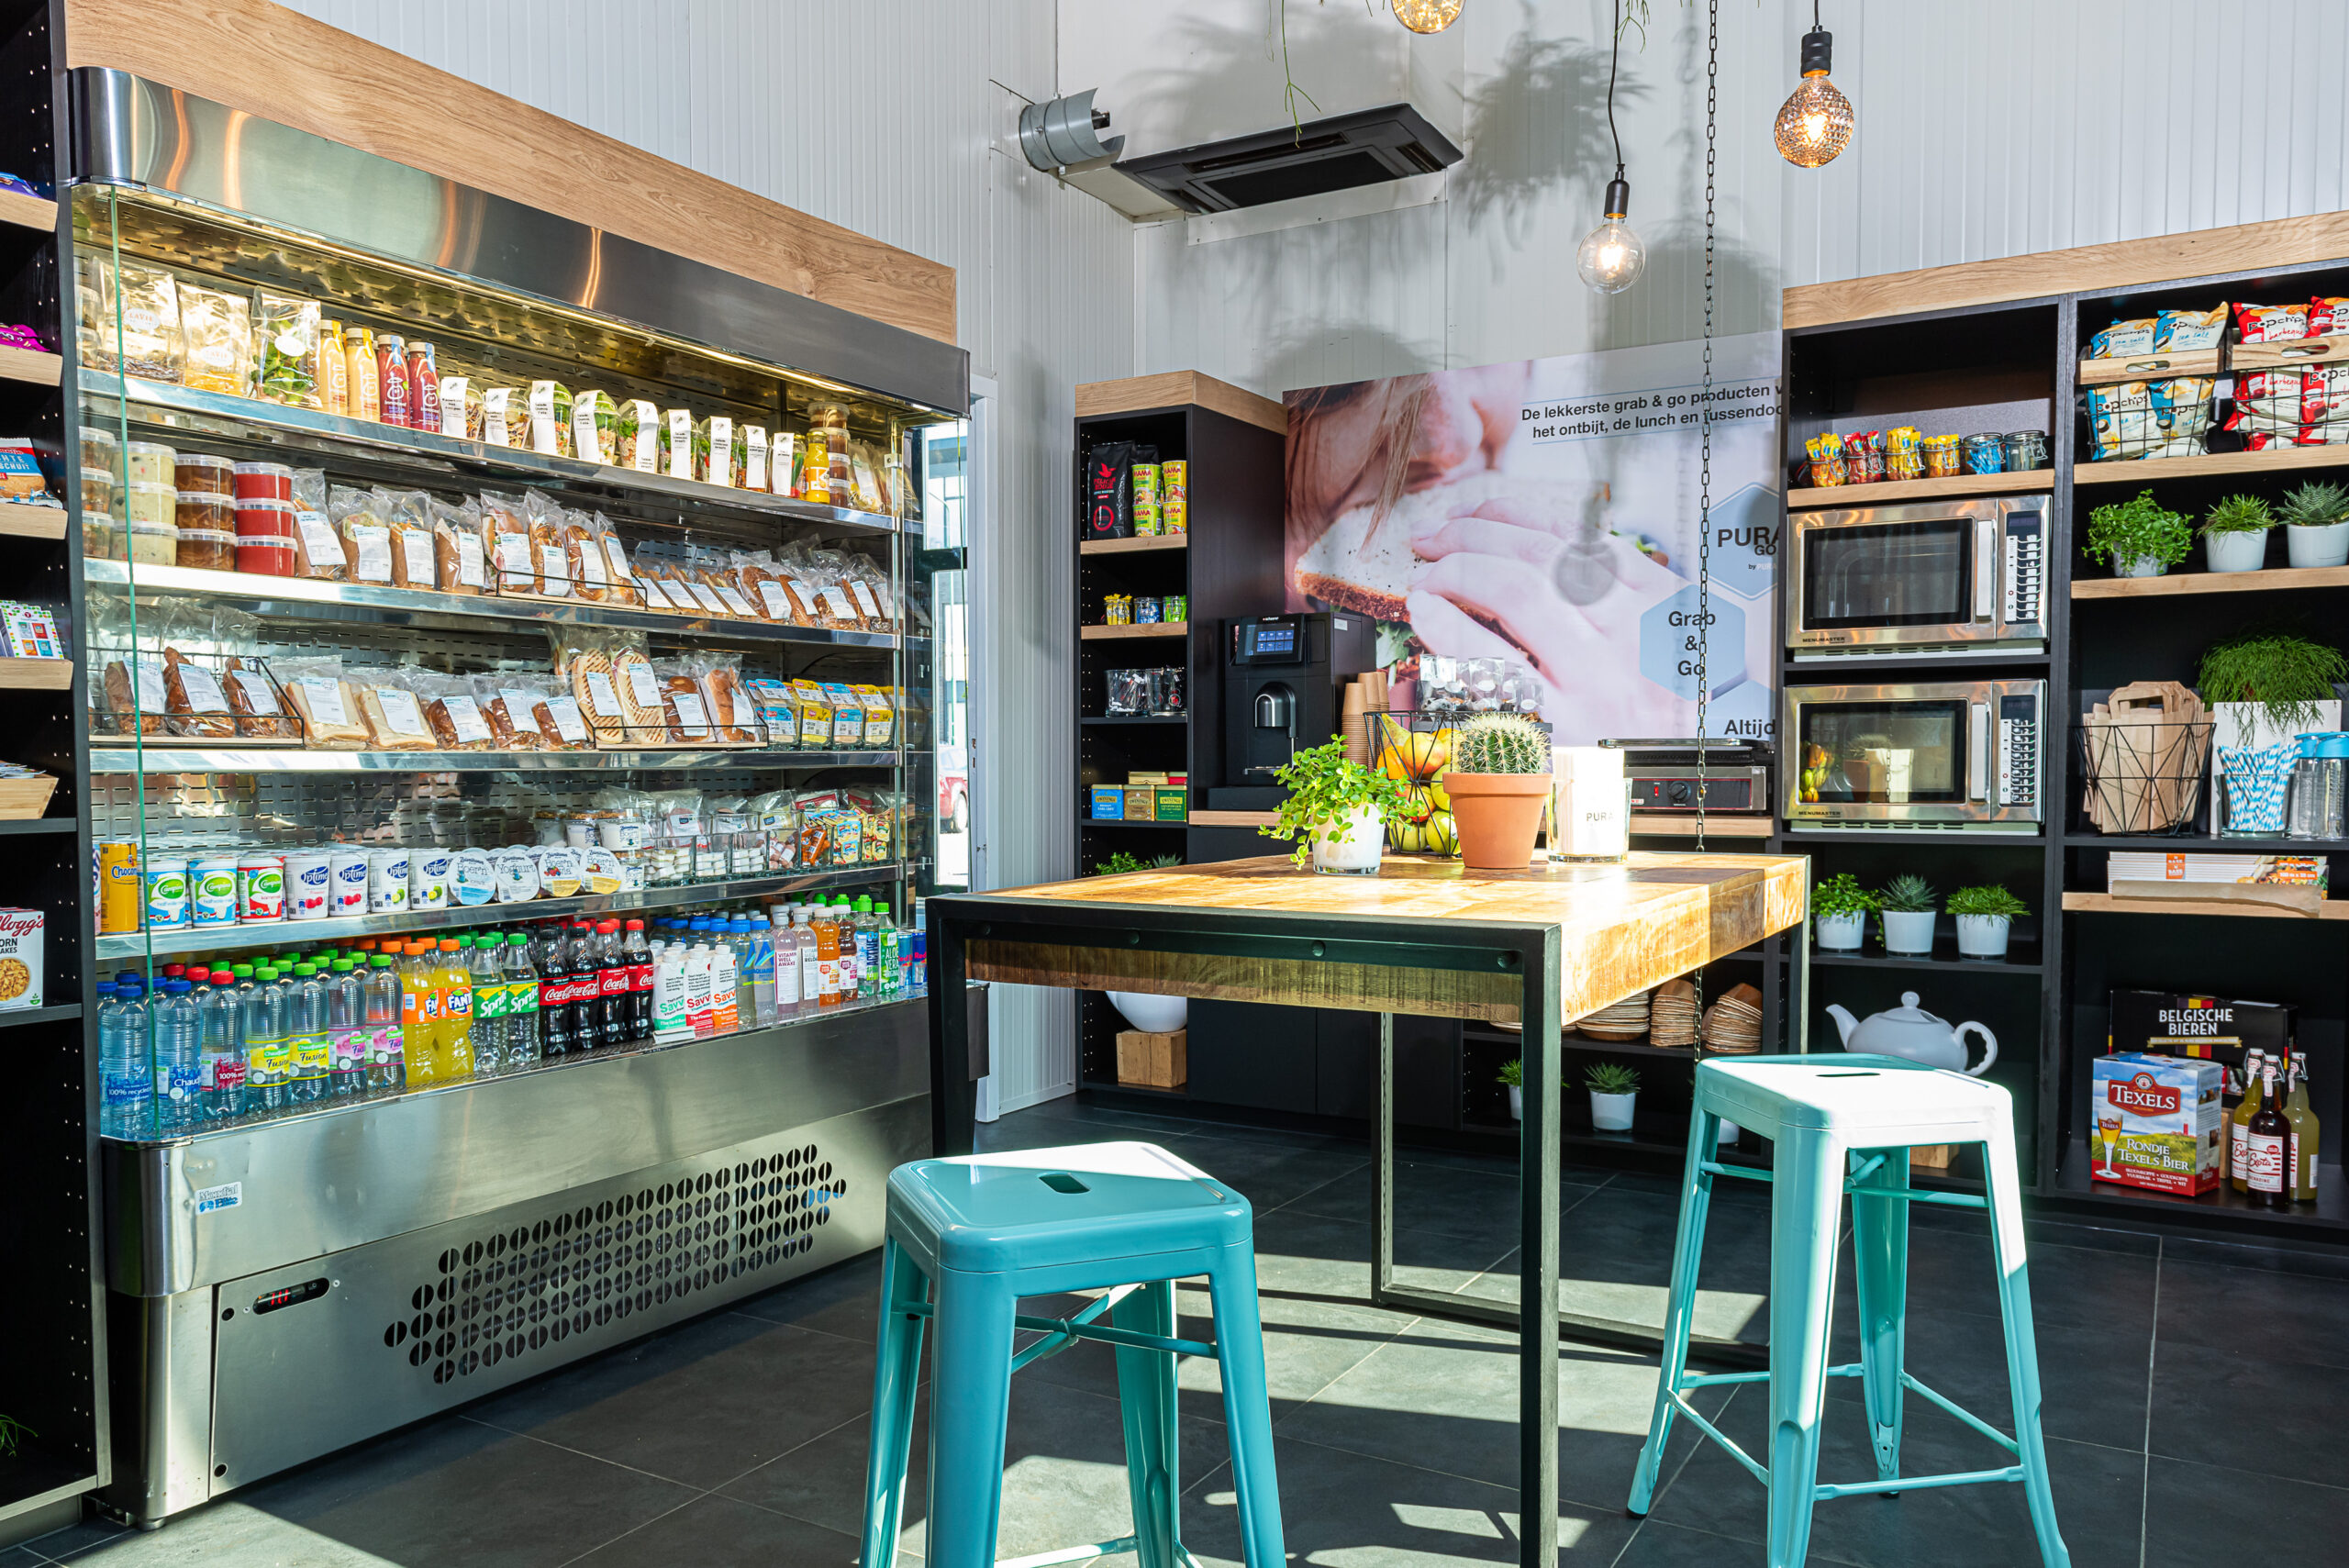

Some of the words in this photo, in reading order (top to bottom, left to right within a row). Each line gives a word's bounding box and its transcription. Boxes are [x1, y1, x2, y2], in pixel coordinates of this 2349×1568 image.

[1521, 408, 1542, 421] De
[1544, 402, 1610, 418] lekkerste
[1614, 396, 1648, 415] grab
[1653, 395, 1663, 407] &
[1667, 394, 1687, 410] go
[1690, 384, 1771, 406] producten
[1532, 424, 1555, 439] het
[1559, 420, 1609, 437] ontbijt,
[1613, 417, 1631, 431] de
[1635, 412, 1676, 428] lunch
[1681, 412, 1699, 425] en
[1754, 544, 1777, 556] GO
[1668, 610, 1717, 627] Grab
[1685, 635, 1698, 651] &
[1677, 660, 1706, 676] Go
[1724, 718, 1776, 739] Altijd
[885, 946, 899, 959] ALOE
[2158, 1008, 2233, 1022] BELGISCHE
[2168, 1022, 2218, 1036] BIEREN
[2111, 1084, 2176, 1109] TEXELS
[2127, 1139, 2170, 1155] RONDJE
[2118, 1149, 2160, 1166] TEXELS
[2163, 1156, 2189, 1172] BIER
